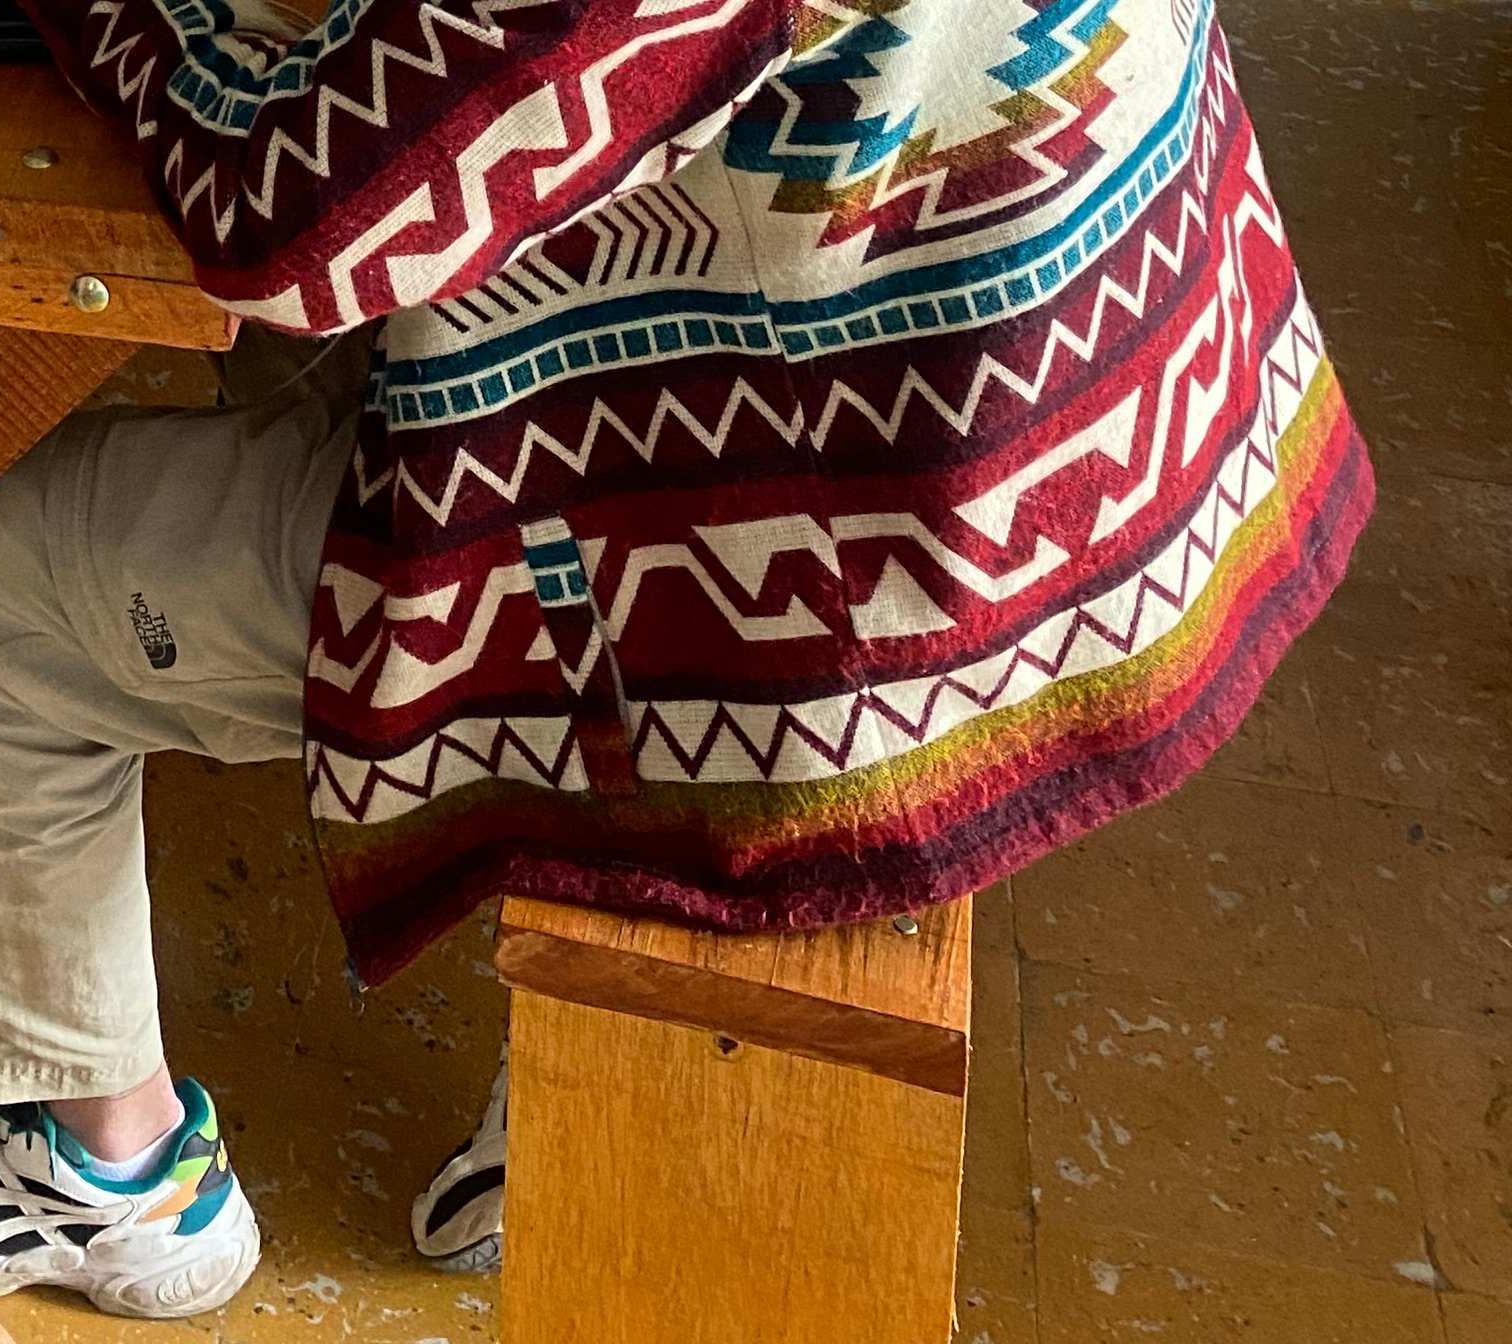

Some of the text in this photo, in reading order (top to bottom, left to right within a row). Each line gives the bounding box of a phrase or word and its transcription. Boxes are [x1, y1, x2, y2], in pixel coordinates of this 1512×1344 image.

[128, 609, 152, 650] FACE
[131, 592, 162, 645] NORTH
[153, 611, 175, 644] THE
